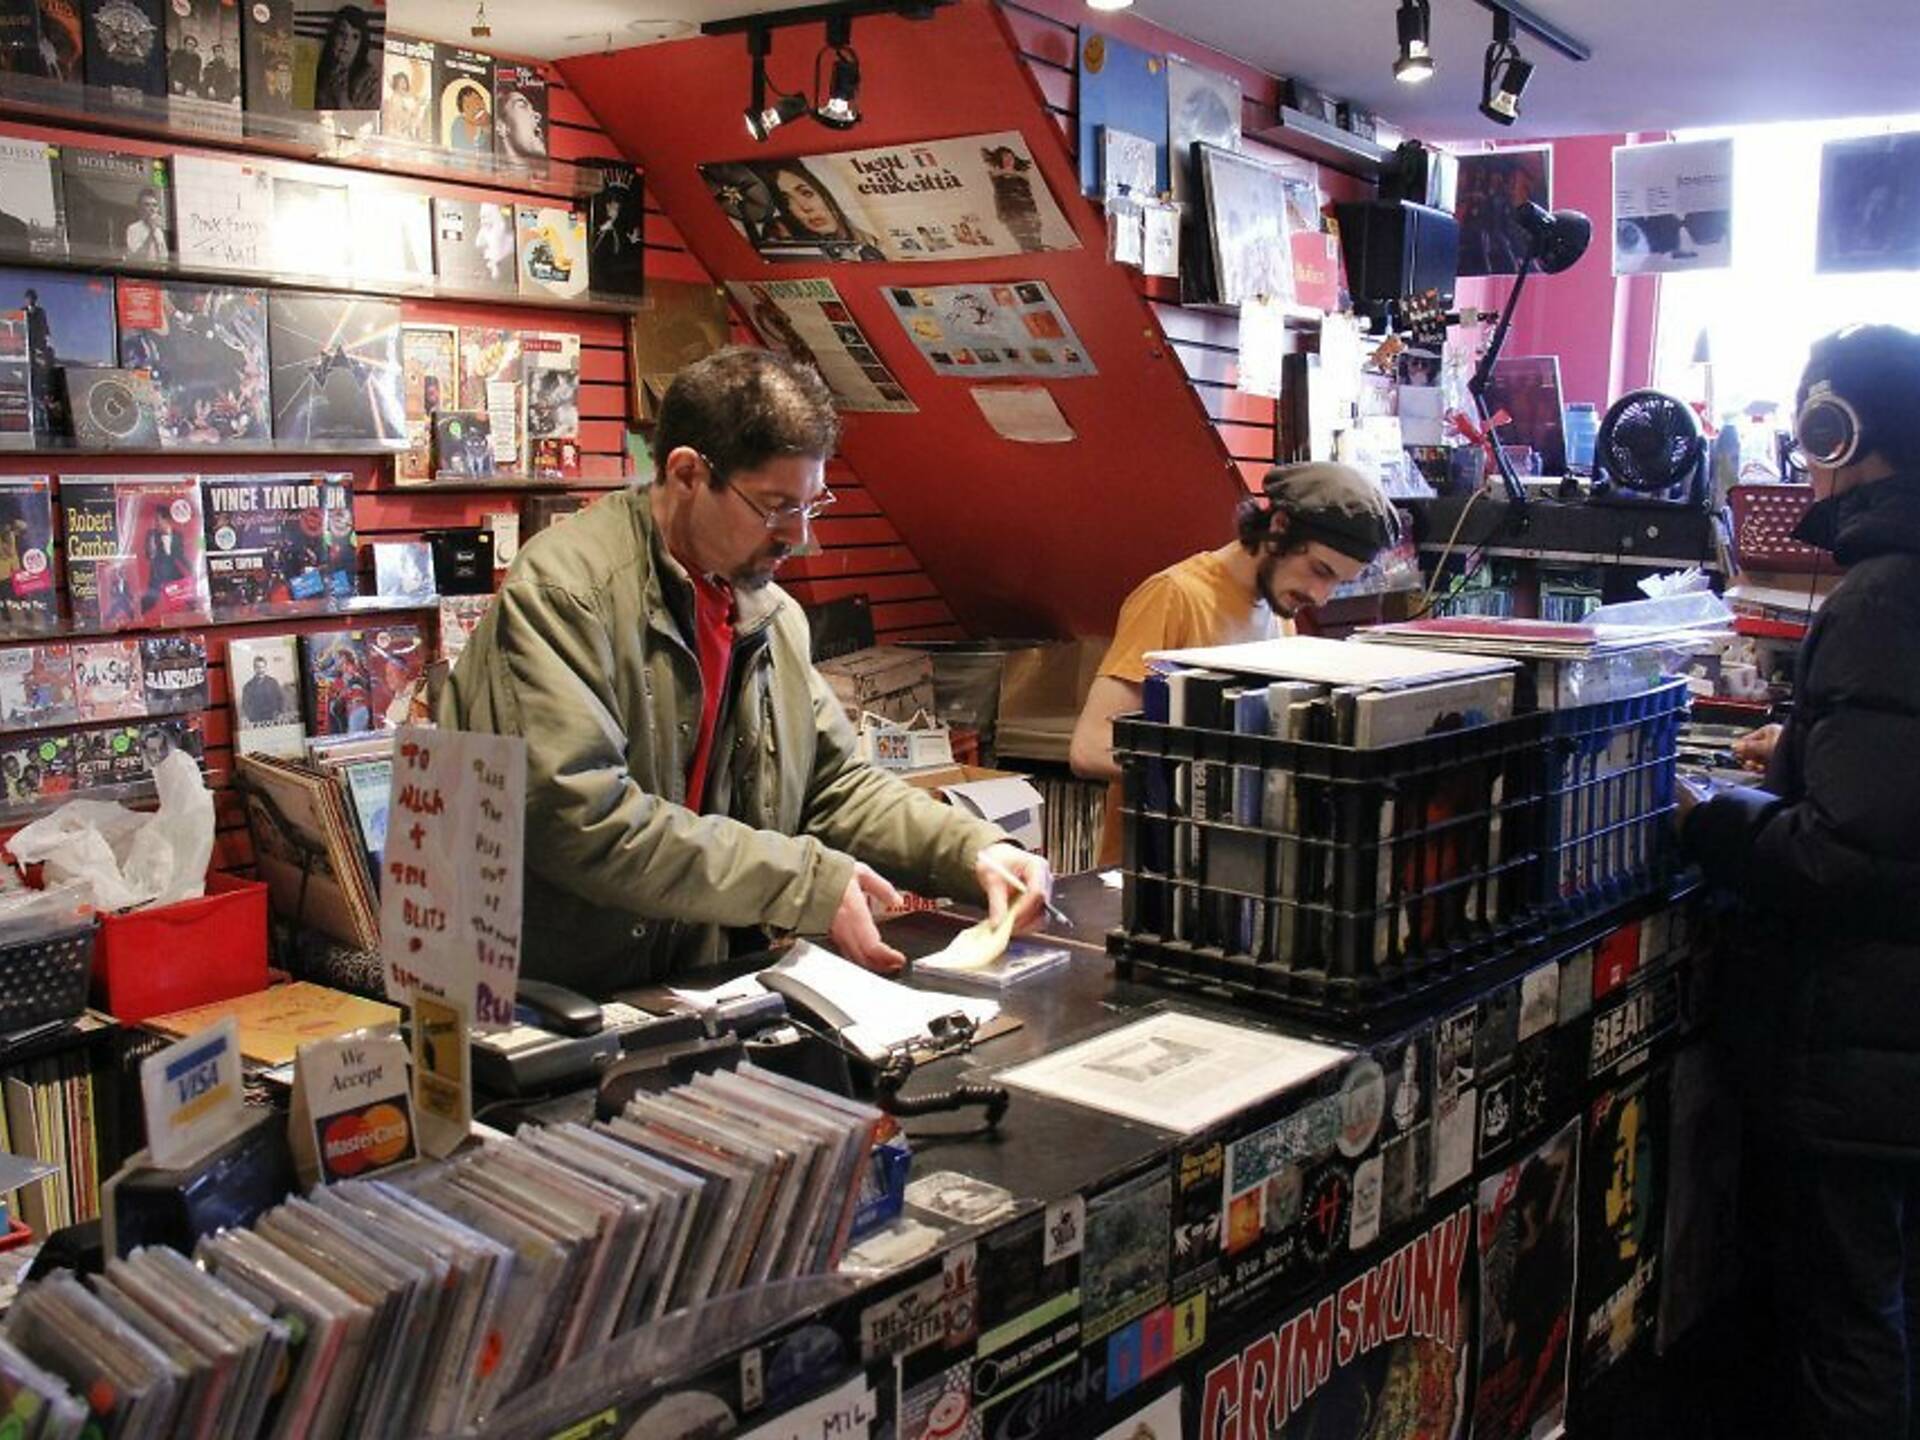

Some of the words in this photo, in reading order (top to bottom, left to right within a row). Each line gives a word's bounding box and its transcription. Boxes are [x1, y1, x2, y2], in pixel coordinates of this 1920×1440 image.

[210, 487, 258, 512] VINCE
[262, 485, 319, 510] TAYLOR
[67, 507, 113, 533] Robert
[68, 535, 118, 557] Gordon
[340, 1047, 366, 1067] We
[178, 1060, 219, 1105] VISA
[329, 1063, 383, 1093] Accept
[325, 1121, 407, 1160] MasterCard
